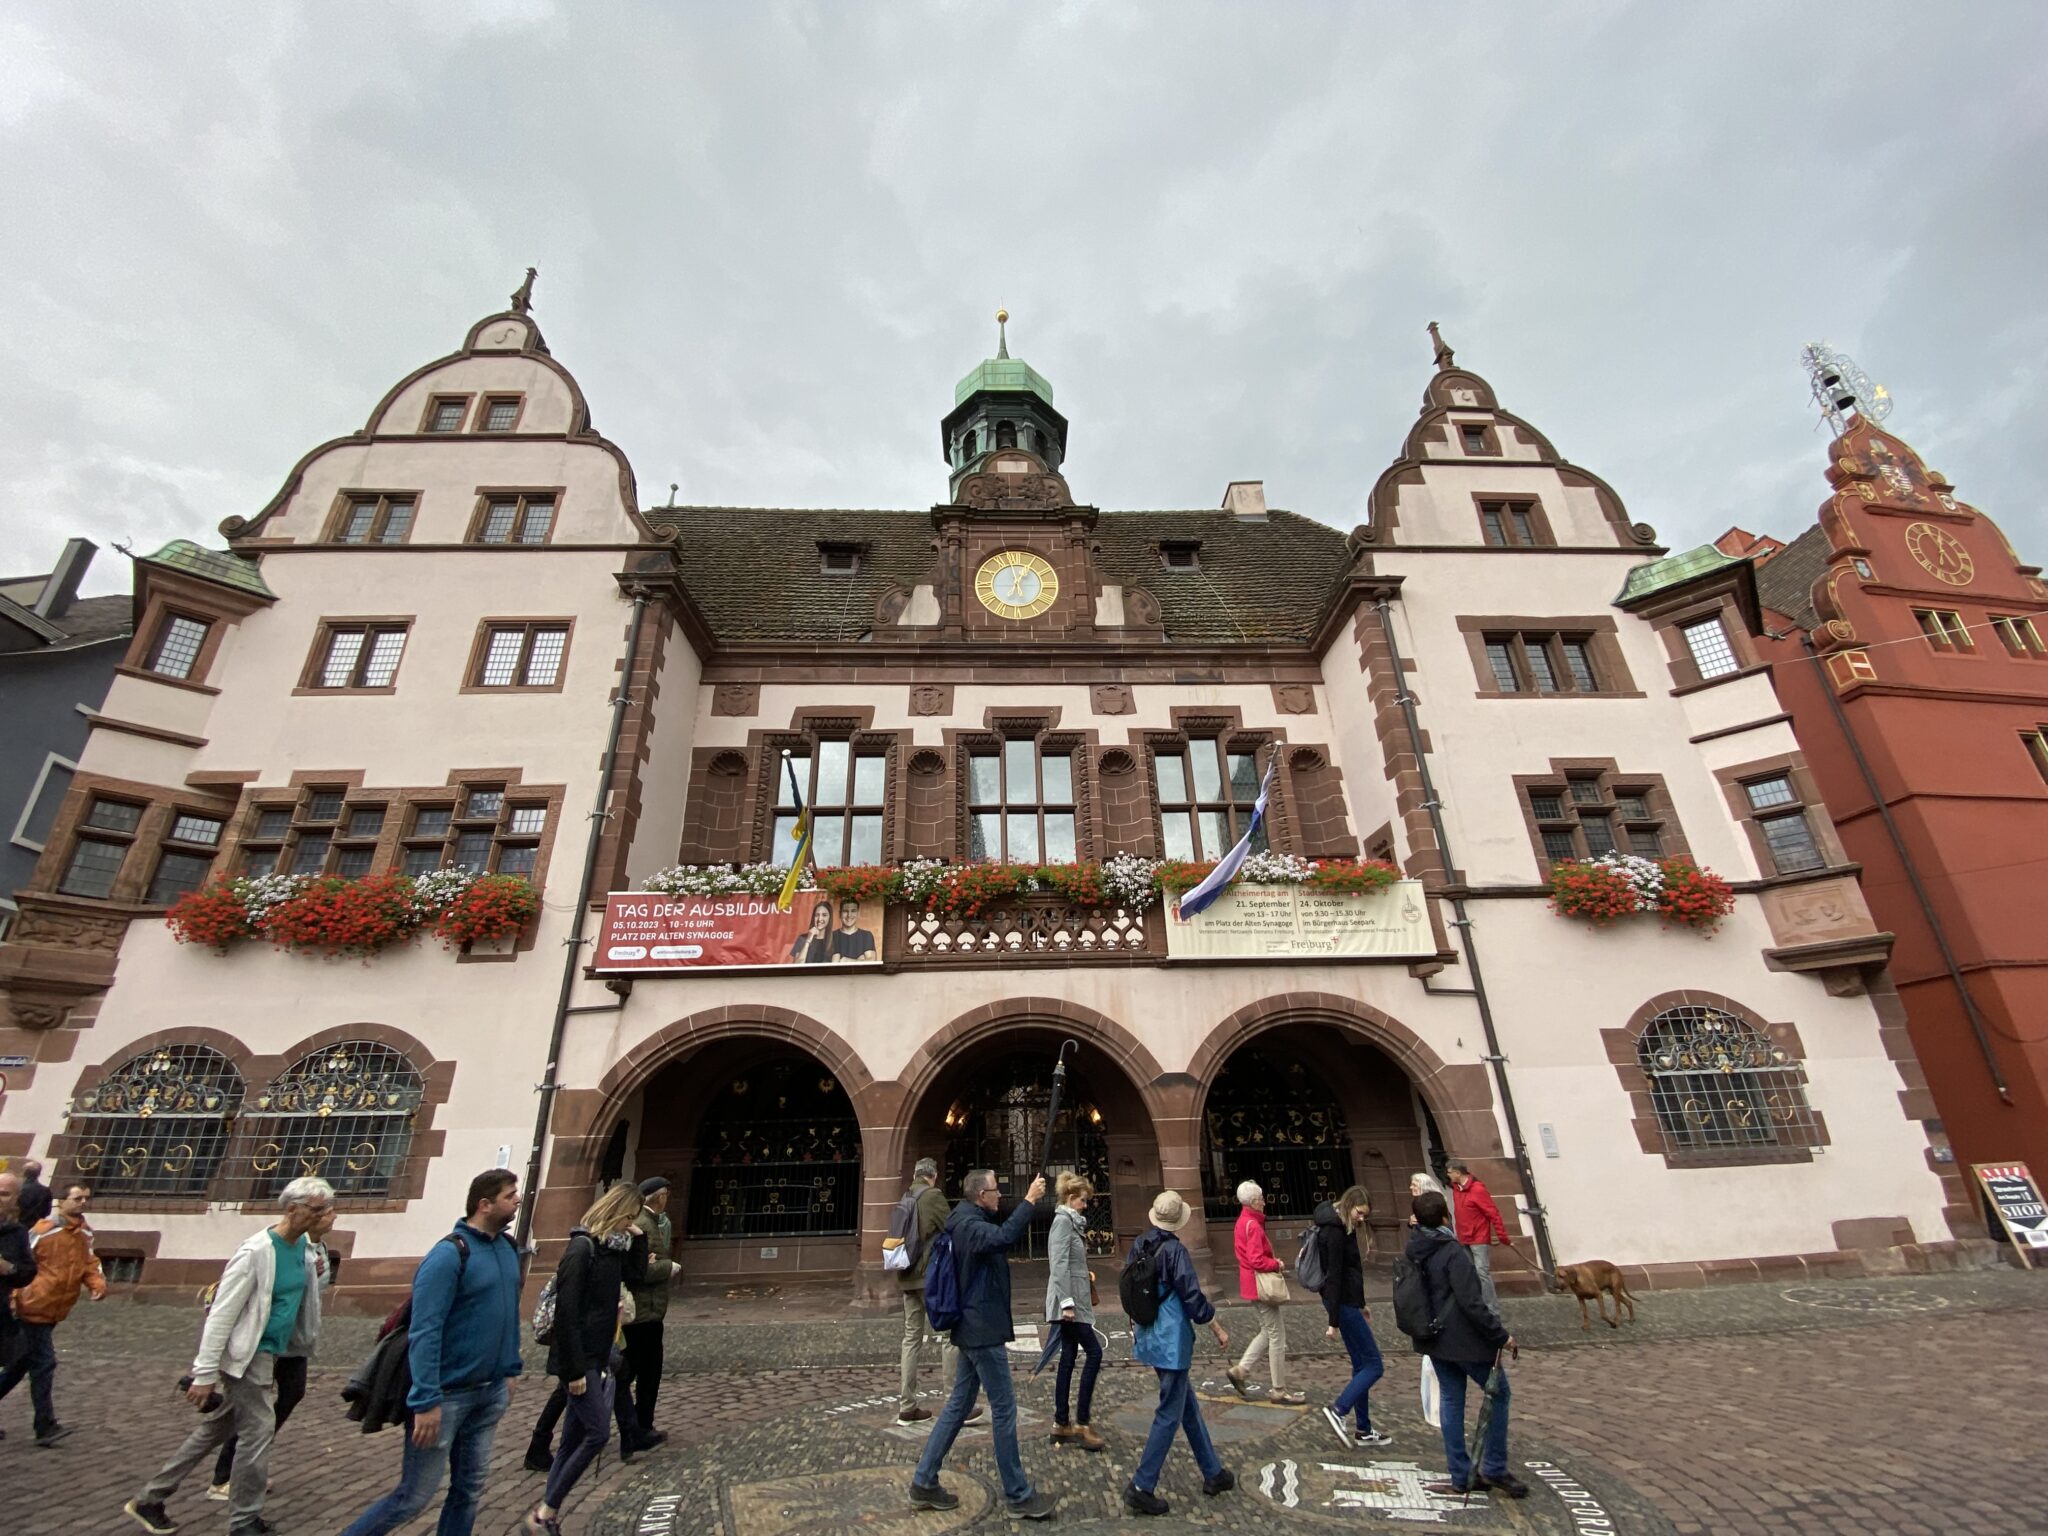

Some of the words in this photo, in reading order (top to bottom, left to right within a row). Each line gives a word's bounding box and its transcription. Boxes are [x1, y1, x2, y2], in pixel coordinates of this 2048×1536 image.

[1222, 890, 1276, 898] Alzheimertag
[1236, 900, 1247, 908] 21.
[1249, 900, 1290, 909] September
[616, 904, 648, 918] TAG
[653, 903, 685, 917] DER
[612, 921, 659, 929] 05.10.2023
[669, 920, 695, 928] 10-16
[696, 920, 714, 928] UHR
[1262, 920, 1293, 928] Synagoge
[1312, 919, 1348, 927] Bürgerhaus
[1349, 919, 1375, 927] Seepark
[610, 932, 639, 941] PLATZ
[639, 932, 657, 940] DER
[658, 932, 685, 940] ALTEN
[686, 931, 734, 940] SYNAGOGE
[1290, 939, 1332, 950] Freiburg
[2001, 1204, 2043, 1217] SHOP
[823, 1388, 948, 1415] INNSBUC
[1523, 1461, 1616, 1536] GUILDFORD
